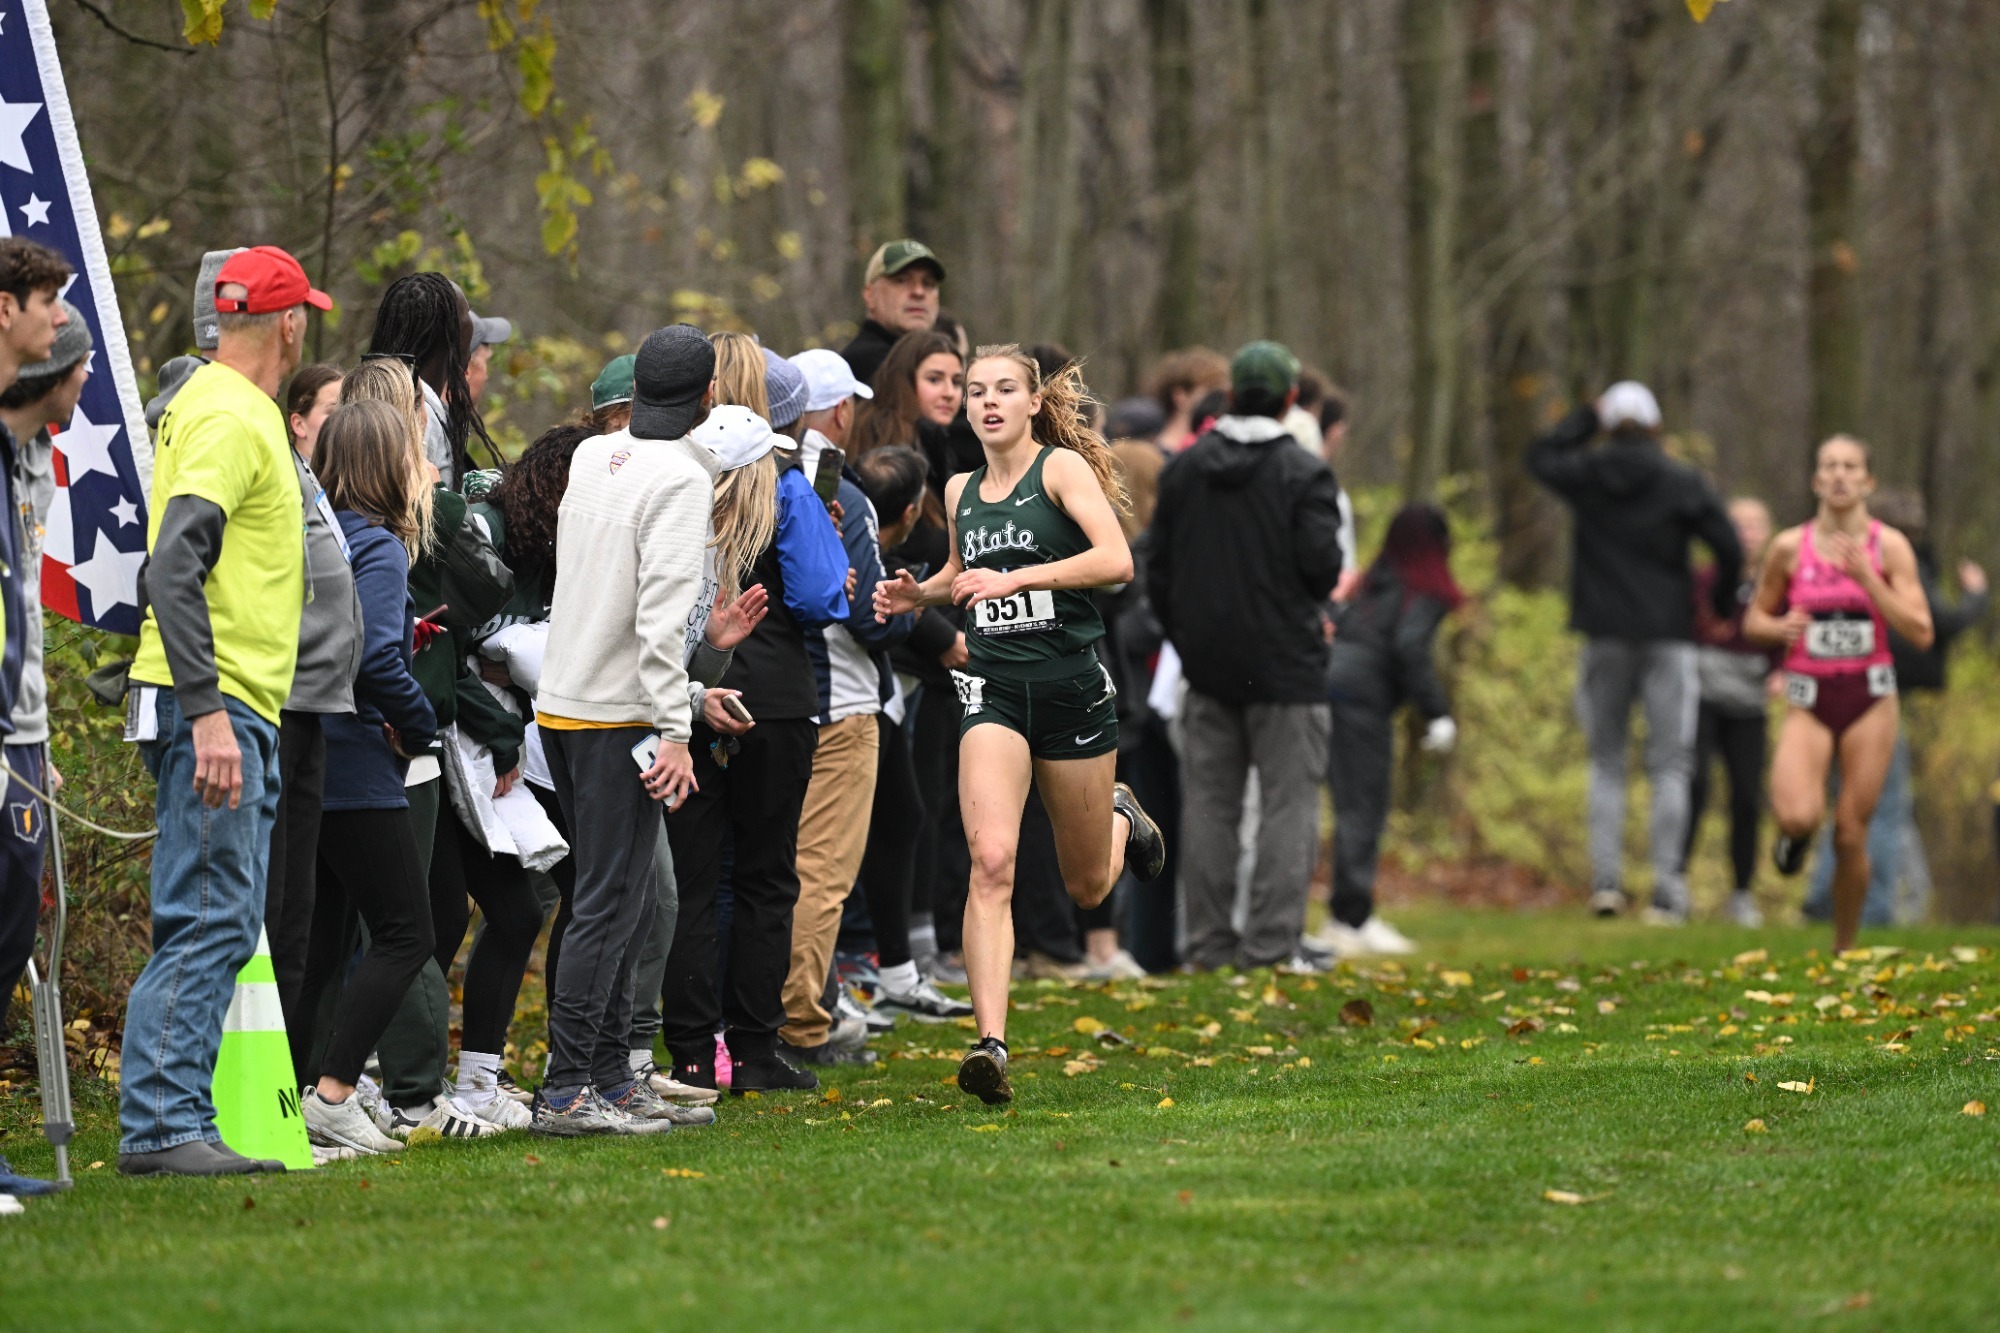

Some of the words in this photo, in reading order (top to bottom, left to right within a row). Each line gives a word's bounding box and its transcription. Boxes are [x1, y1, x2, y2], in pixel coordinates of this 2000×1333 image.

[962, 520, 1039, 567] State
[985, 590, 1034, 623] 551
[278, 1087, 303, 1119] N
